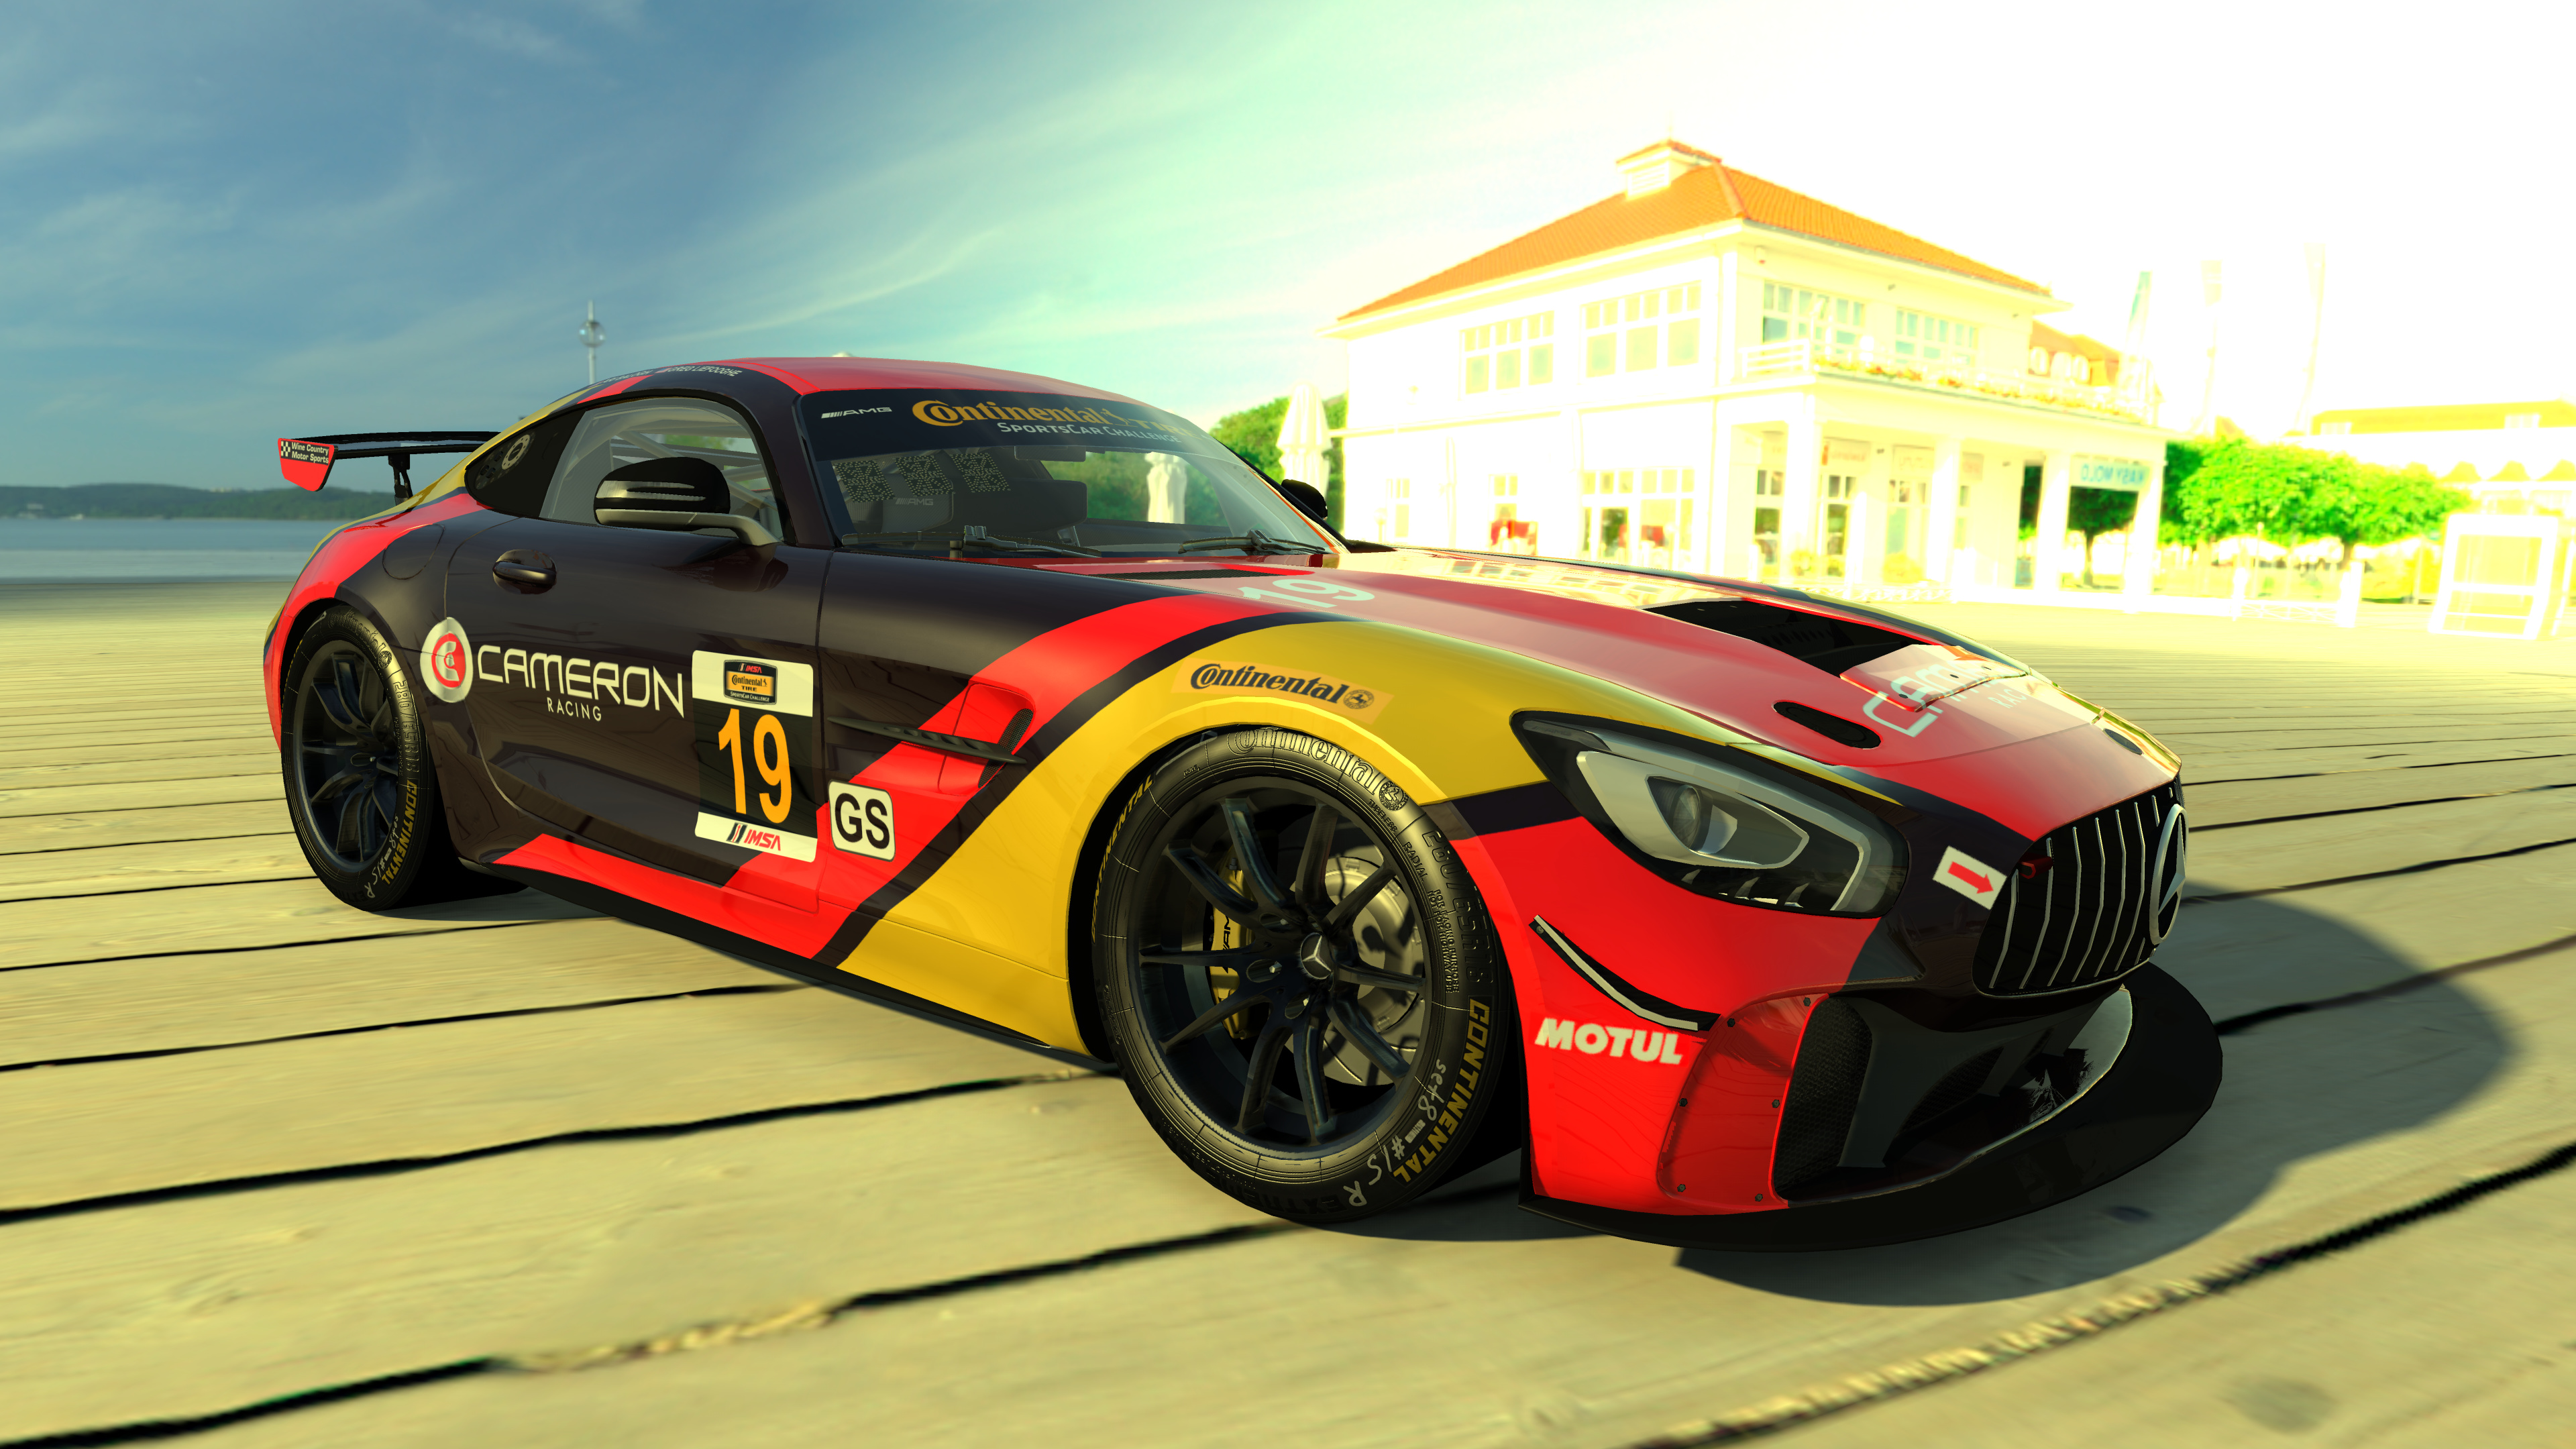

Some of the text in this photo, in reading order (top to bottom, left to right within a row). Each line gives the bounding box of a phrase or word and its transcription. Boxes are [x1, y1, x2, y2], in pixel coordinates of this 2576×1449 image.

[843, 407, 892, 416] AMG
[912, 400, 1110, 426] Continental
[1128, 418, 1203, 440] TIRE
[291, 441, 329, 455] Wine Country
[291, 451, 329, 464] Motor Sports
[1237, 578, 1375, 608] 19
[477, 644, 685, 718] CAMERON
[731, 674, 763, 686] Continental
[745, 664, 763, 674] IMSA
[1190, 663, 1349, 704] Continental
[547, 696, 602, 722] RACING
[718, 708, 793, 824] 19
[381, 779, 418, 886] CONTINENTAL
[834, 792, 891, 849] GS
[743, 826, 782, 852] IMSA
[1366, 798, 1399, 833] TUBELESS
[1402, 841, 1428, 882] RADIAL
[1426, 890, 1438, 910] NOT
[1433, 889, 1445, 908] FOR
[1534, 1017, 1682, 1065] MOTUL
[1393, 998, 1490, 1183] CONTINENTAL
